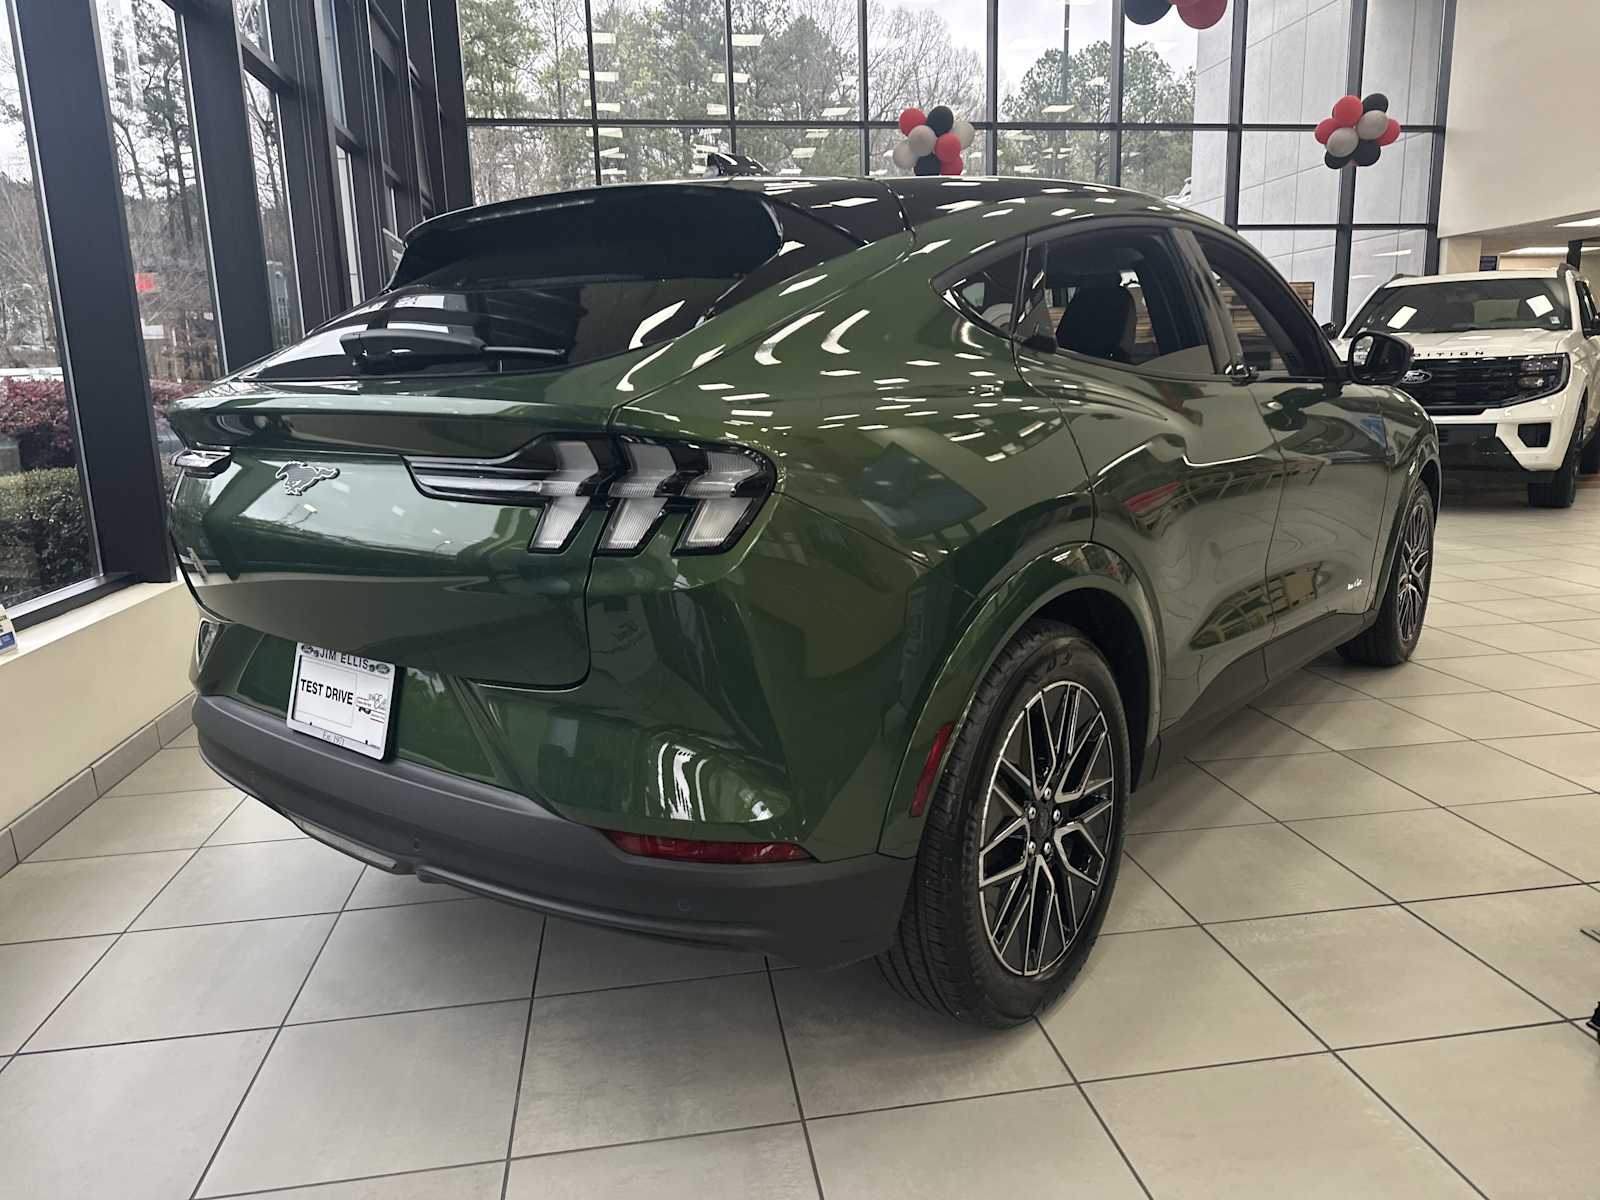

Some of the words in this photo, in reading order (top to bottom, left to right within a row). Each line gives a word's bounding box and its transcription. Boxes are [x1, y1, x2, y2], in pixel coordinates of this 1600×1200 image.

[320, 648, 337, 661] JIM
[340, 653, 369, 670] ELLIS
[300, 678, 324, 696] TEST
[325, 685, 354, 705] DRIVE
